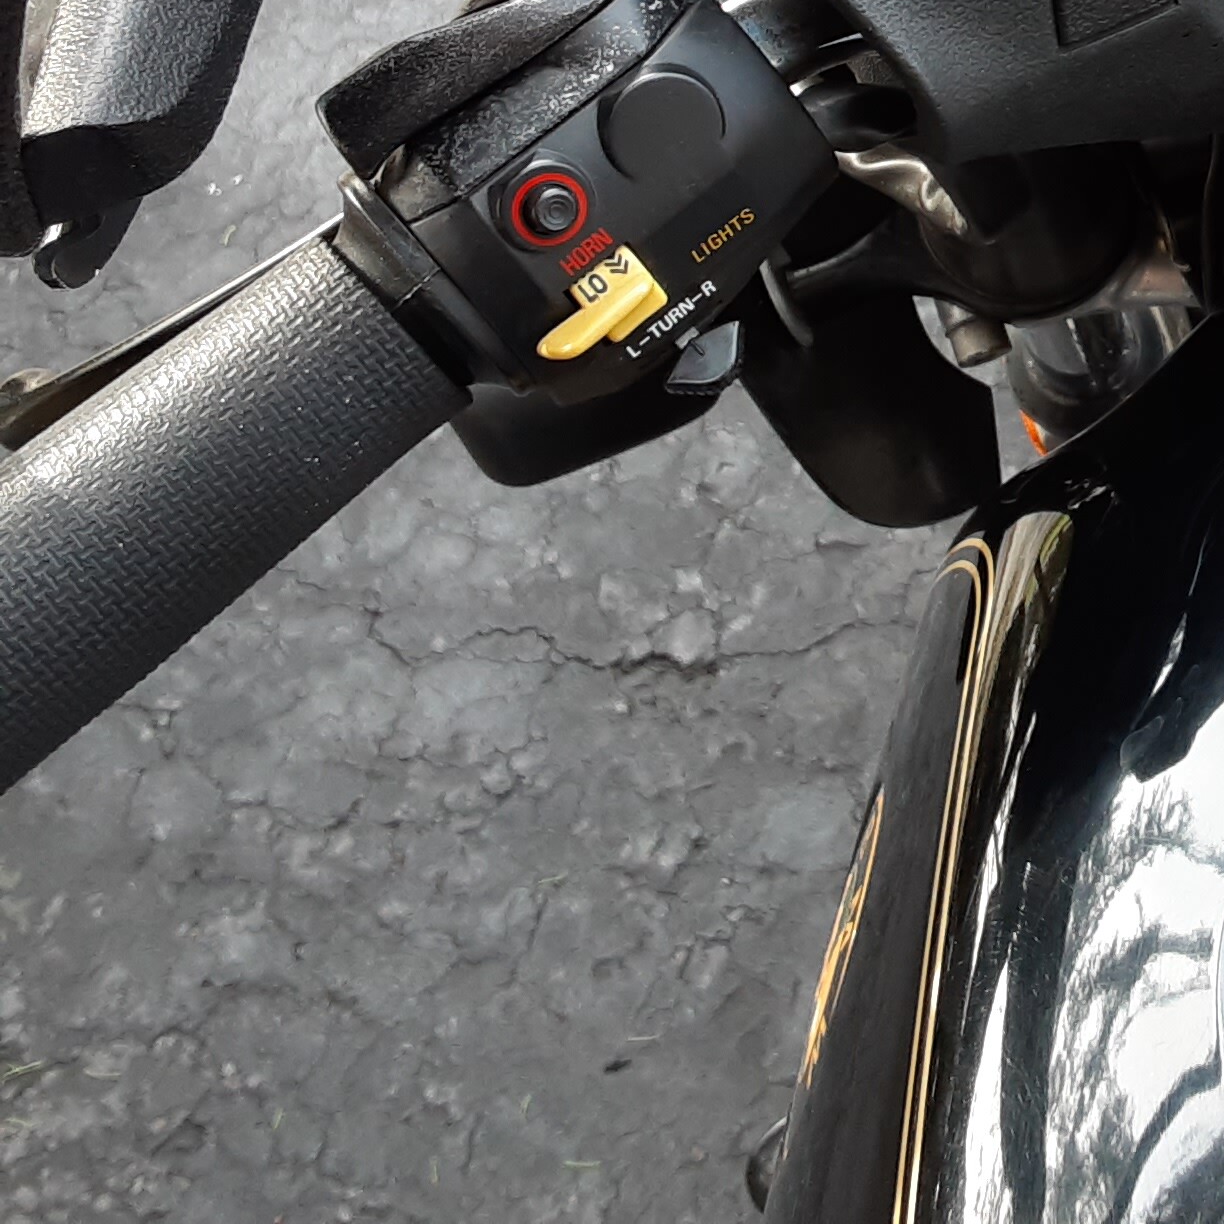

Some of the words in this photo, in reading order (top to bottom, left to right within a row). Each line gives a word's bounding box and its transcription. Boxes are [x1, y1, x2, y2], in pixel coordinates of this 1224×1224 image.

[559, 227, 614, 276] HORN
[691, 207, 756, 264] LIGHTS
[577, 272, 609, 304] LO
